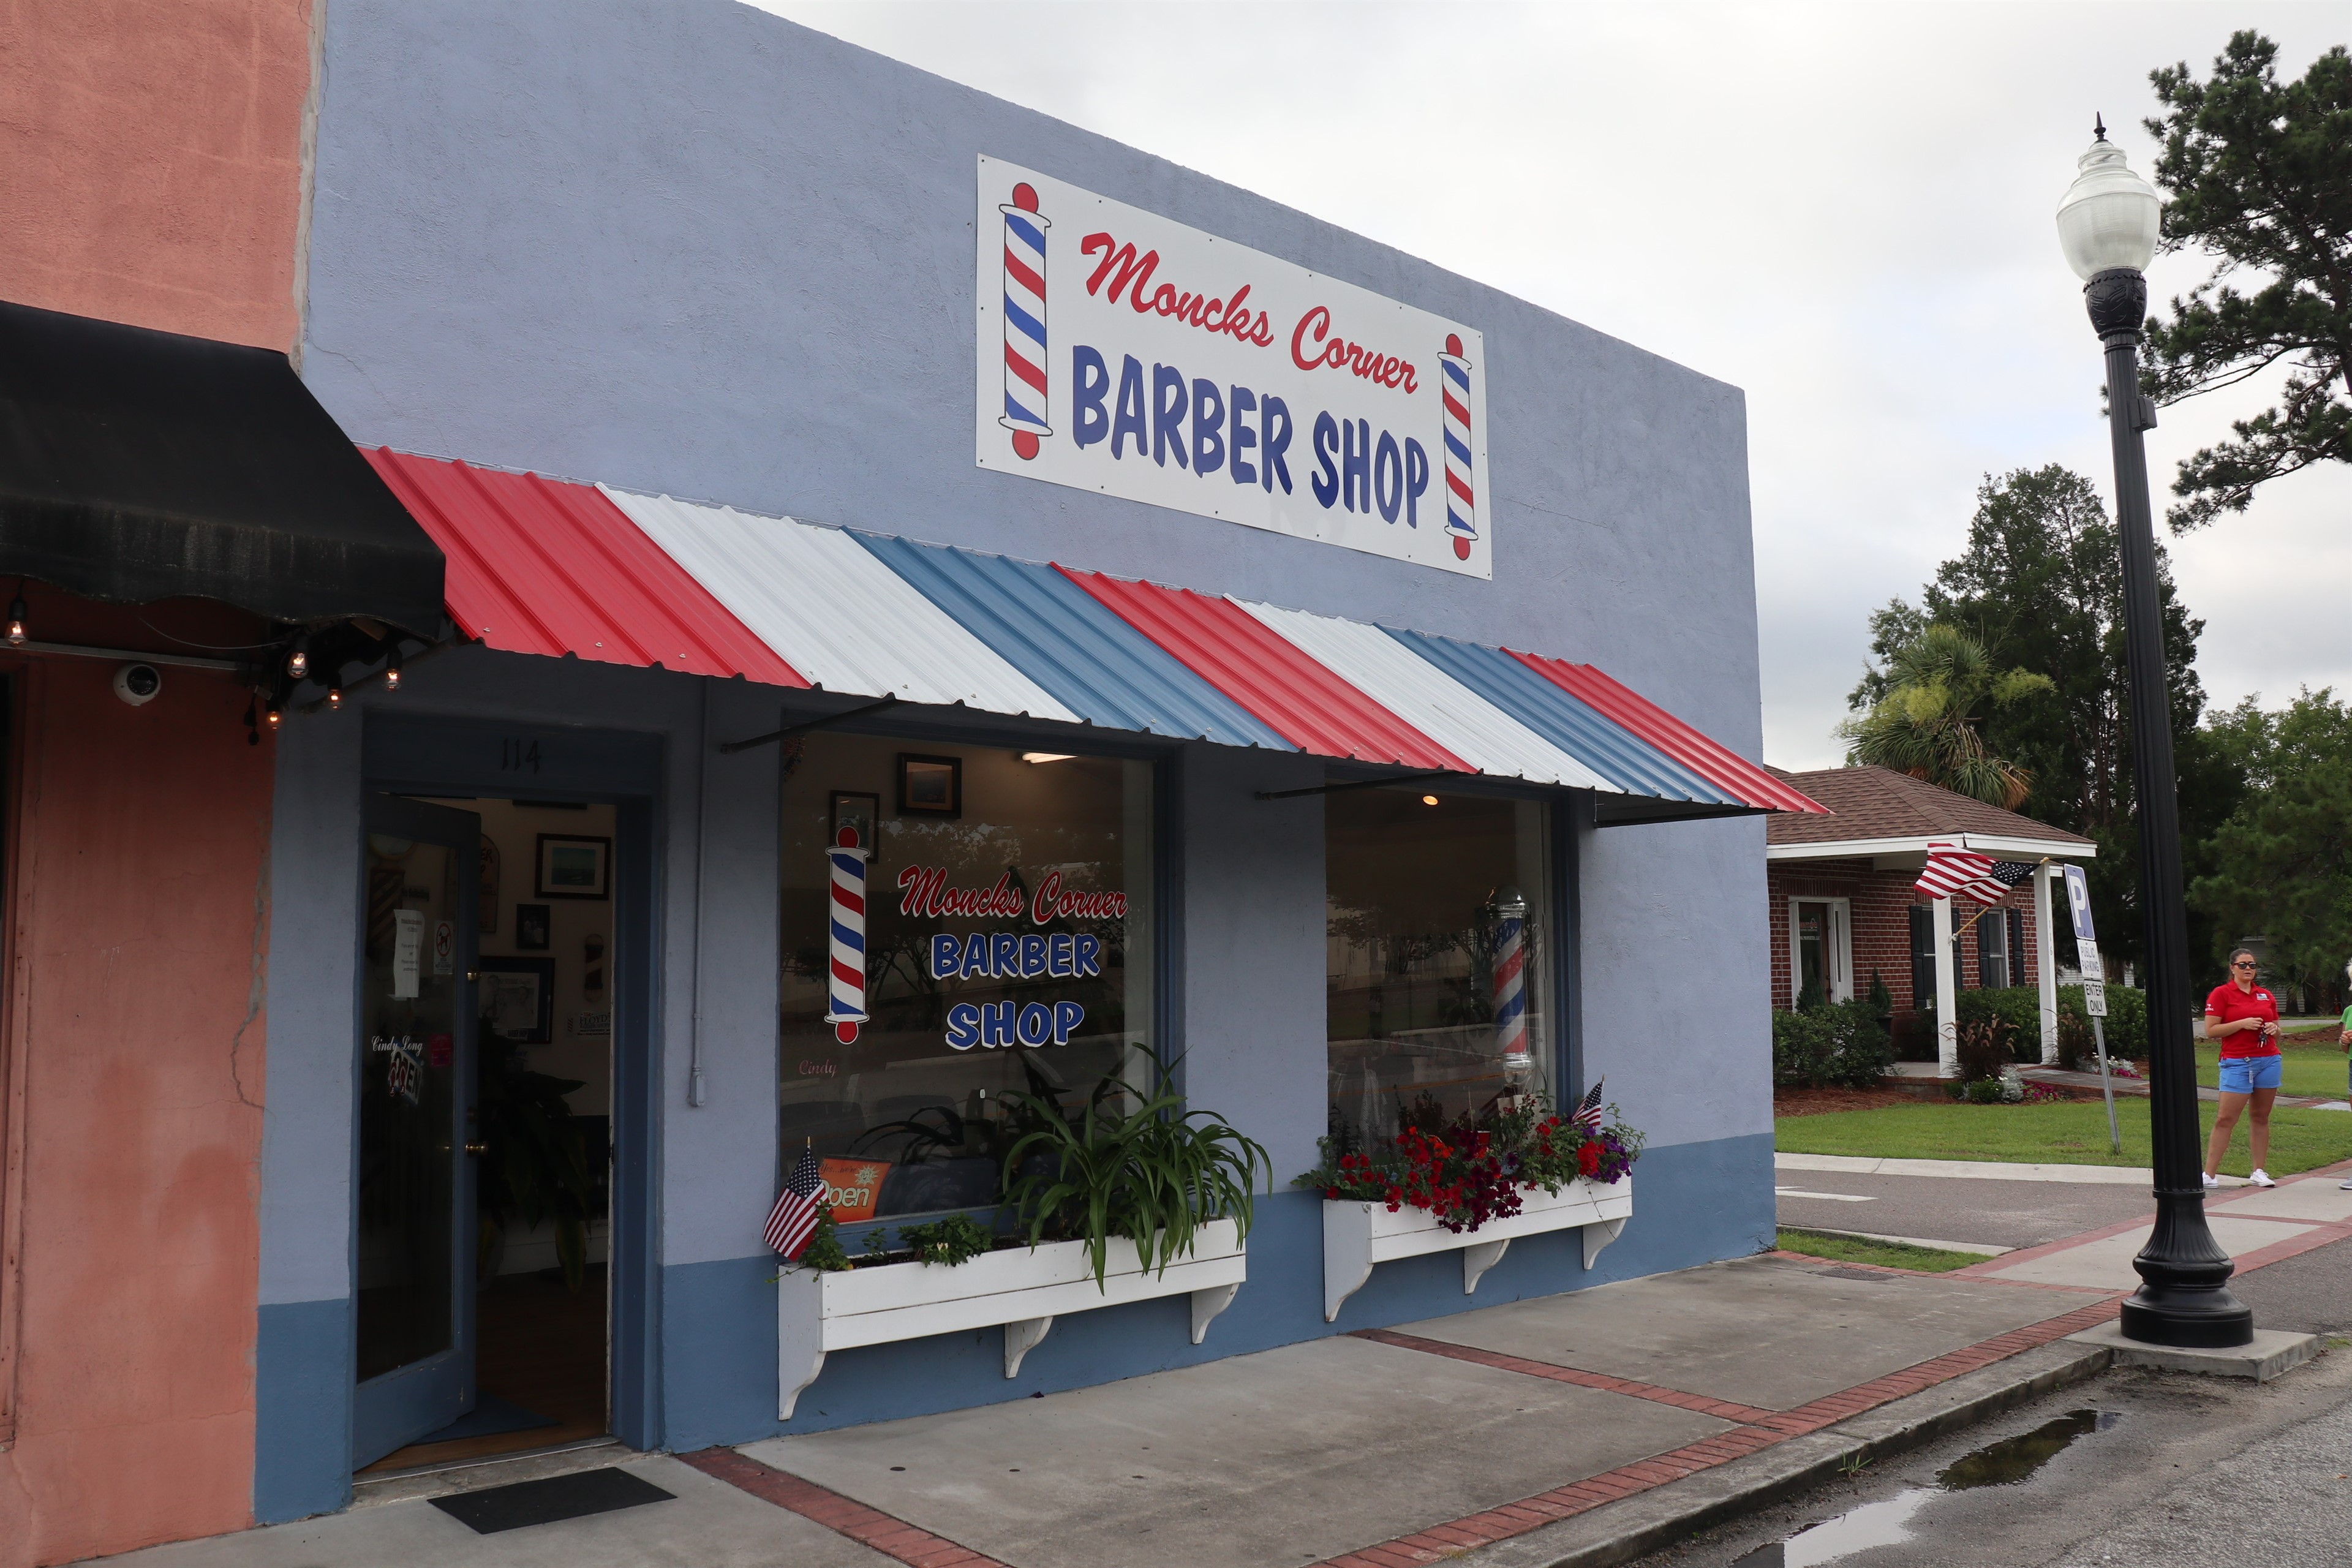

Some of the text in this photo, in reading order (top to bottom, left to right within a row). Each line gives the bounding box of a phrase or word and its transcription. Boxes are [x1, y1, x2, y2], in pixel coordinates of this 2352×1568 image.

[1080, 232, 1419, 394] Moncks Corner
[1072, 345, 1430, 529] BARBER SHOP
[502, 738, 541, 774] 114
[897, 864, 1128, 925] Moncks Corner
[2068, 875, 2086, 929] P
[931, 933, 1100, 981] BARBER
[2080, 946, 2095, 958] PUBLIC
[2081, 960, 2100, 972] PARKING
[2085, 984, 2103, 997] ENTER
[2090, 1000, 2103, 1012] ONLY
[945, 1000, 1085, 1051] SHOP
[371, 1035, 398, 1057] Cindy
[401, 1035, 423, 1057] Long
[799, 1058, 838, 1078] Cindy
